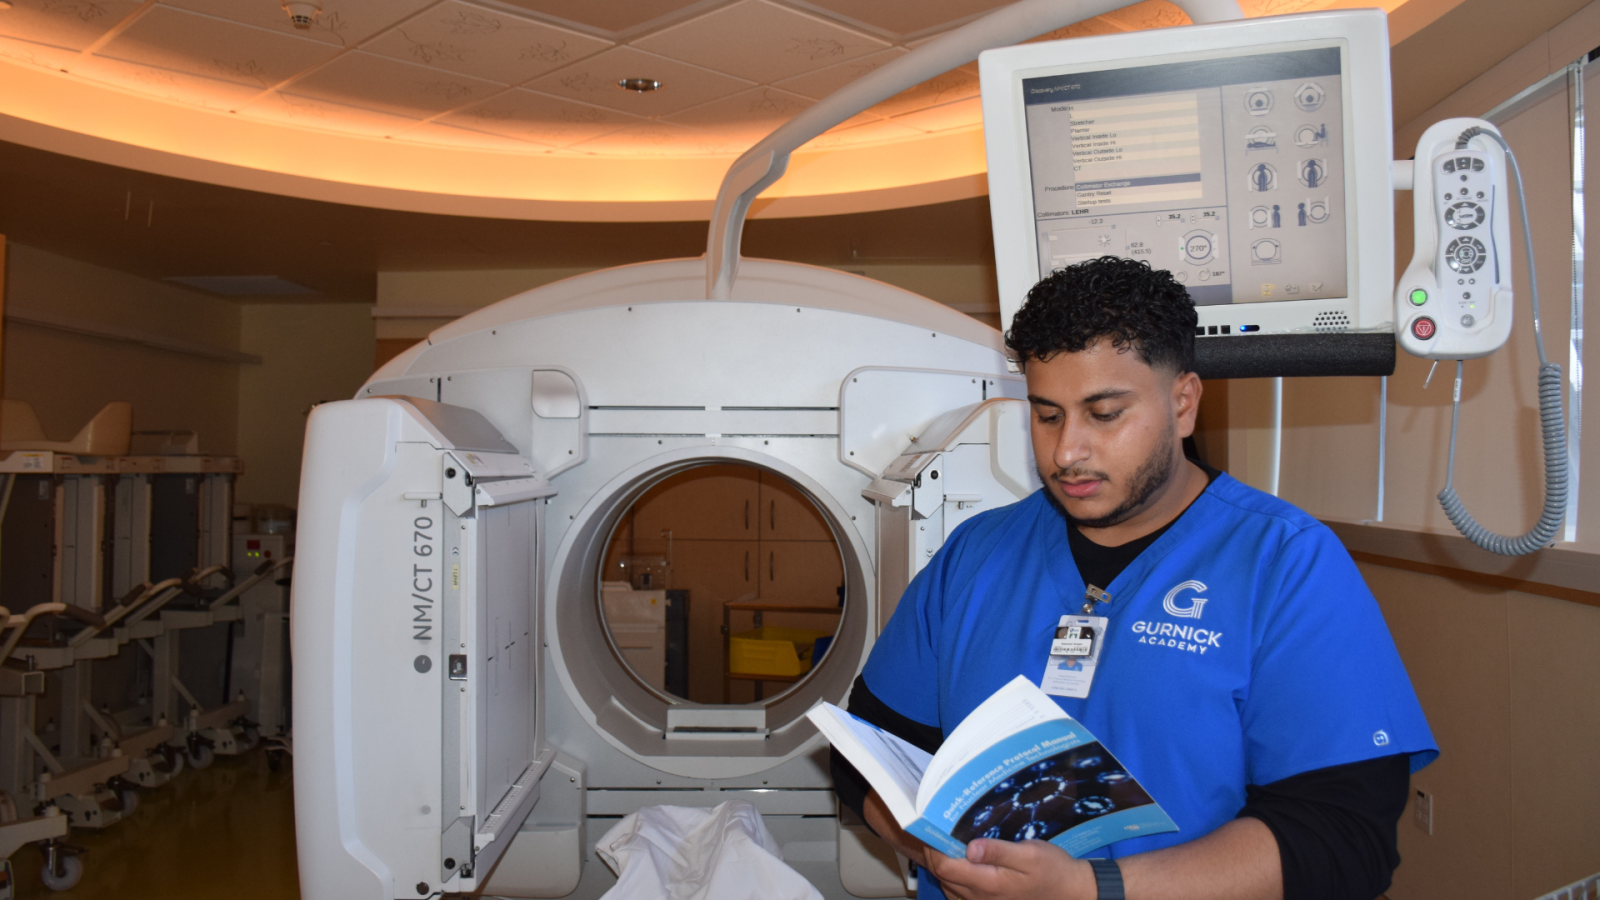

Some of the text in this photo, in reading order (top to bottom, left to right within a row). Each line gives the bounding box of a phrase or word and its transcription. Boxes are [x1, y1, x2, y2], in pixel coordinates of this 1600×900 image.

[1070, 119, 1095, 127] Stretcher
[1071, 134, 1091, 142] Vertical
[1092, 132, 1109, 140] Inside
[1092, 140, 1109, 148] Inside
[1072, 149, 1092, 157] Vertical
[1093, 148, 1114, 156] Outside
[1094, 155, 1115, 163] Outside
[1044, 184, 1075, 193] Procedure:
[1104, 180, 1131, 189] Exchange
[1077, 191, 1095, 199] Gantry
[411, 516, 434, 641] NM/CT 670
[1131, 620, 1223, 648] GURNICK
[1138, 635, 1208, 655] ACADEMY
[943, 731, 1078, 819] Quick-Reference Protocol Manual
[948, 738, 1081, 822] for Nuclear Medicine Technologists
